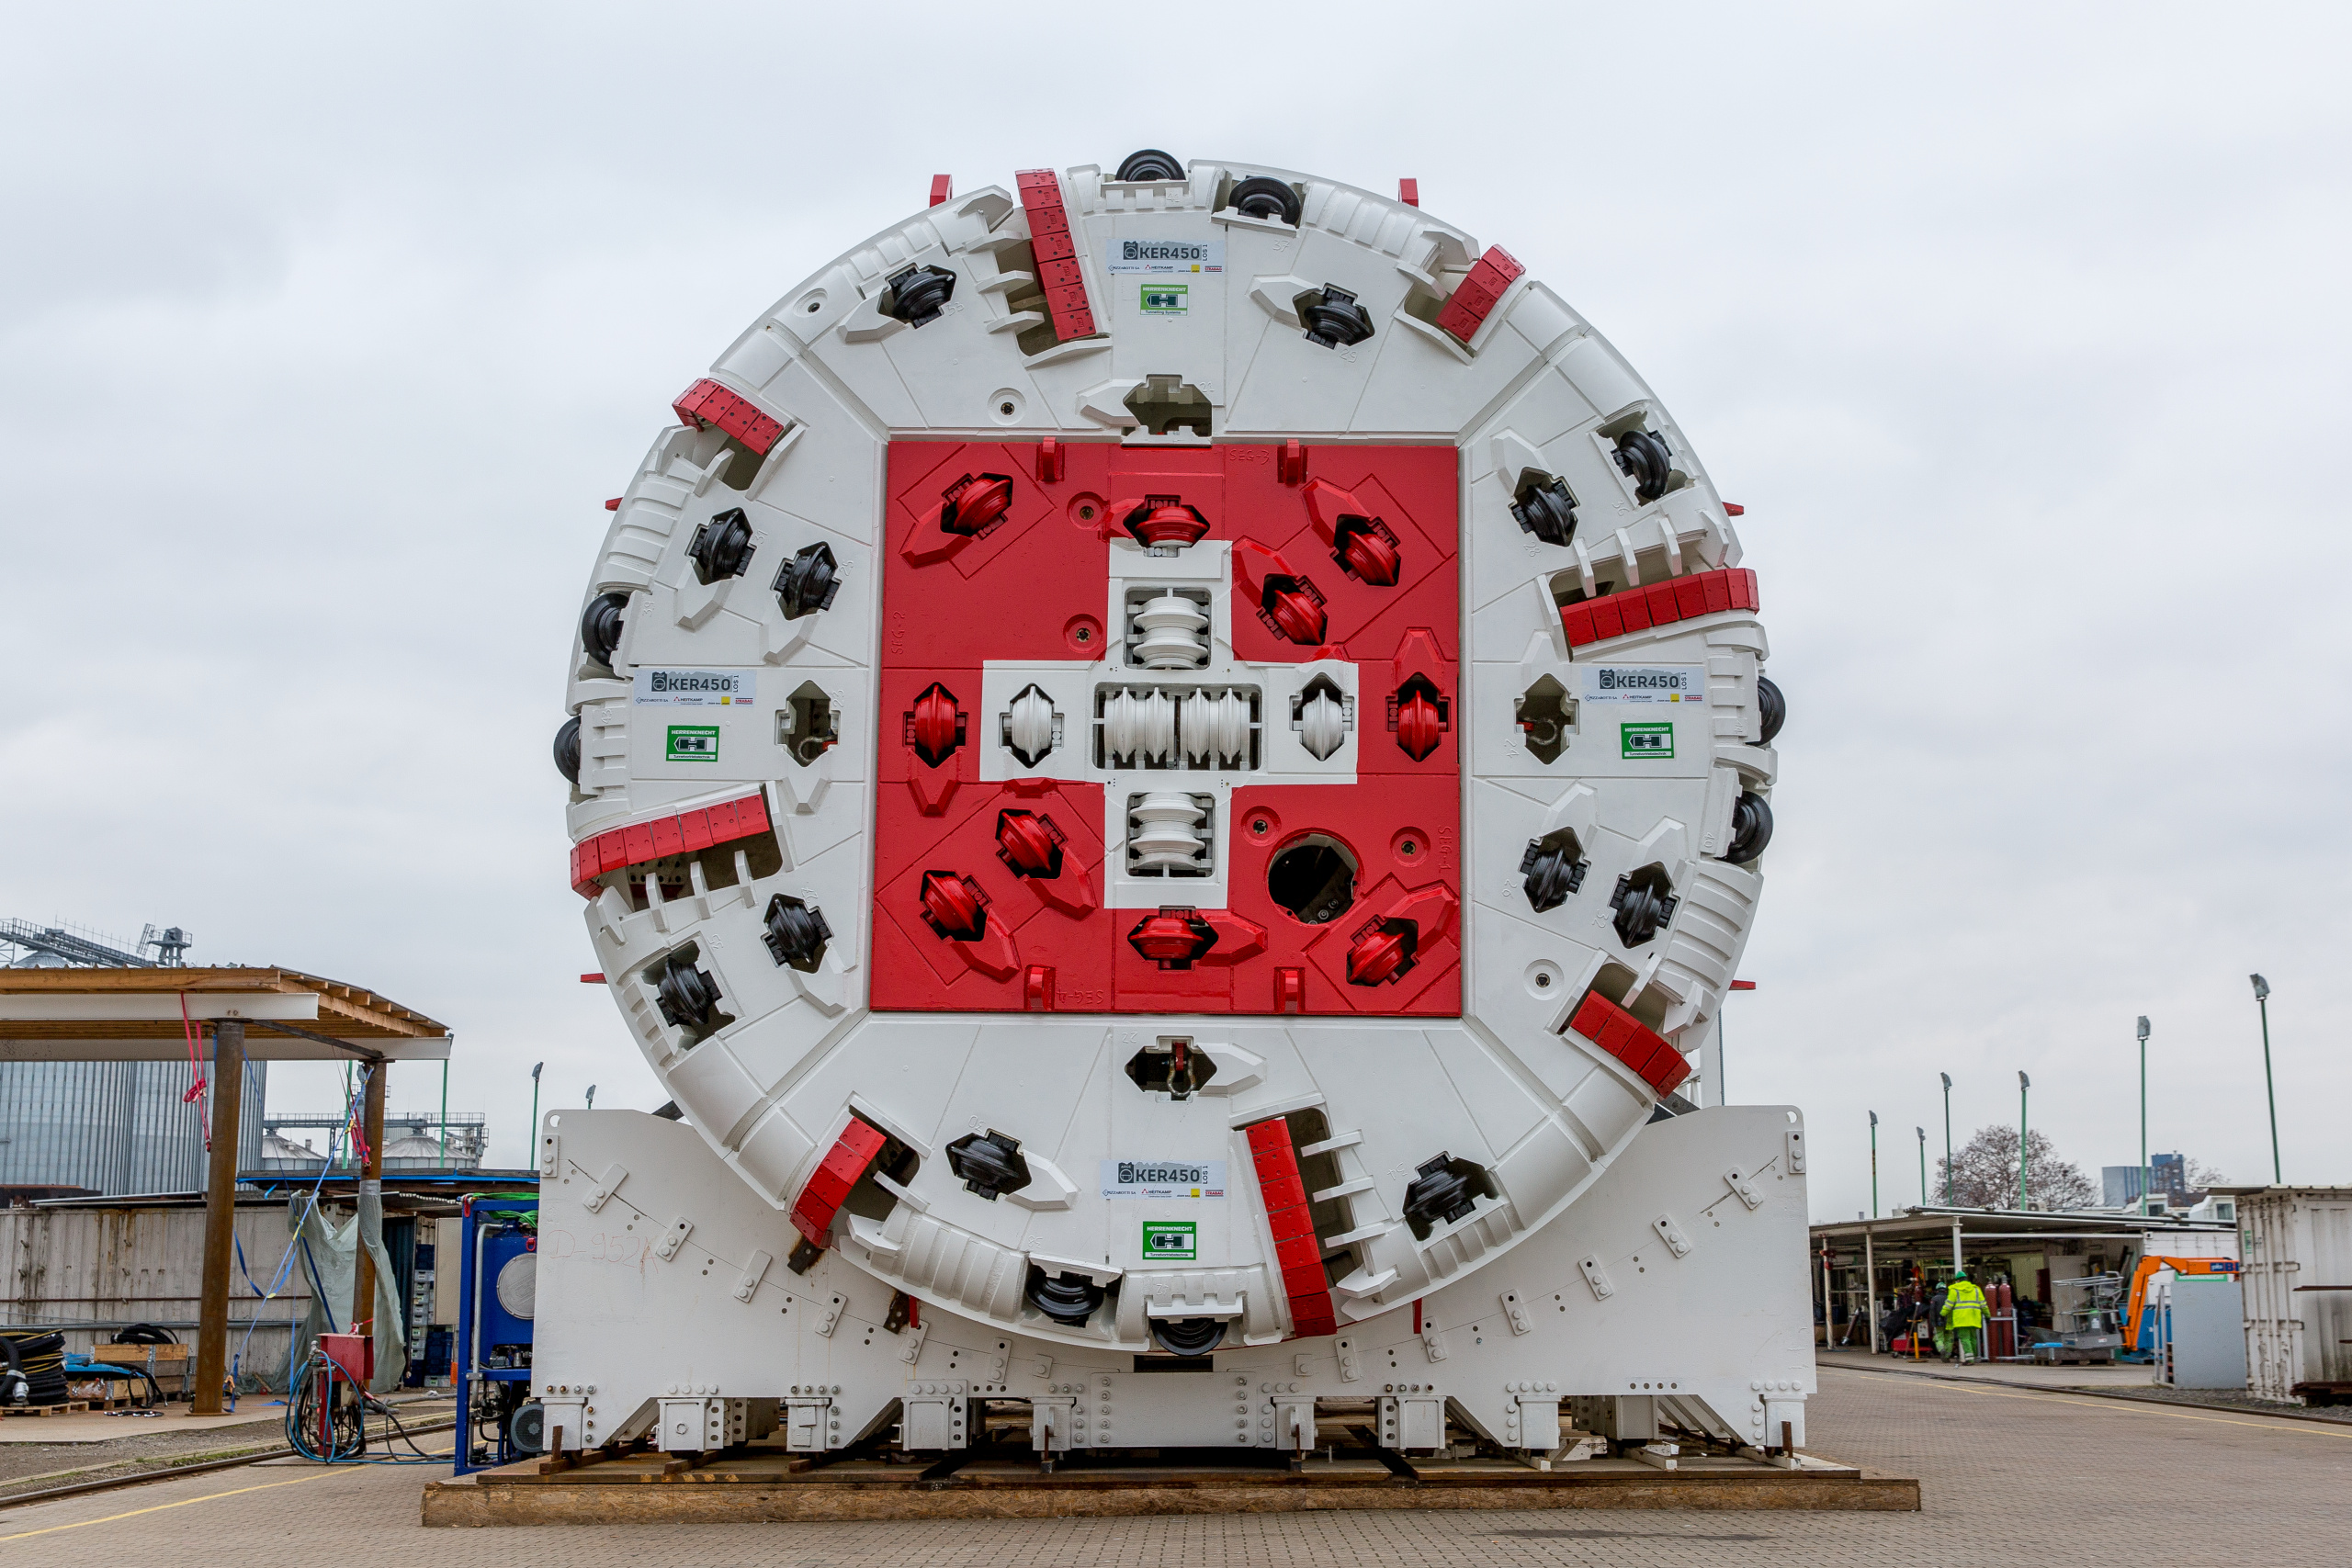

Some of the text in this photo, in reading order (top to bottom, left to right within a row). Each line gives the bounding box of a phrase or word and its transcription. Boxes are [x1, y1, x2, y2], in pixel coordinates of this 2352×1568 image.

[1272, 239, 1290, 253] 37
[1140, 247, 1200, 259] KER450
[1340, 348, 1357, 364] 29
[1229, 448, 1270, 465] SEG-3
[754, 529, 769, 545] 31
[669, 678, 731, 691] KER450
[1616, 675, 1679, 688] KER450
[1122, 1031, 1138, 1044] 22
[1136, 1169, 1200, 1182] KER450
